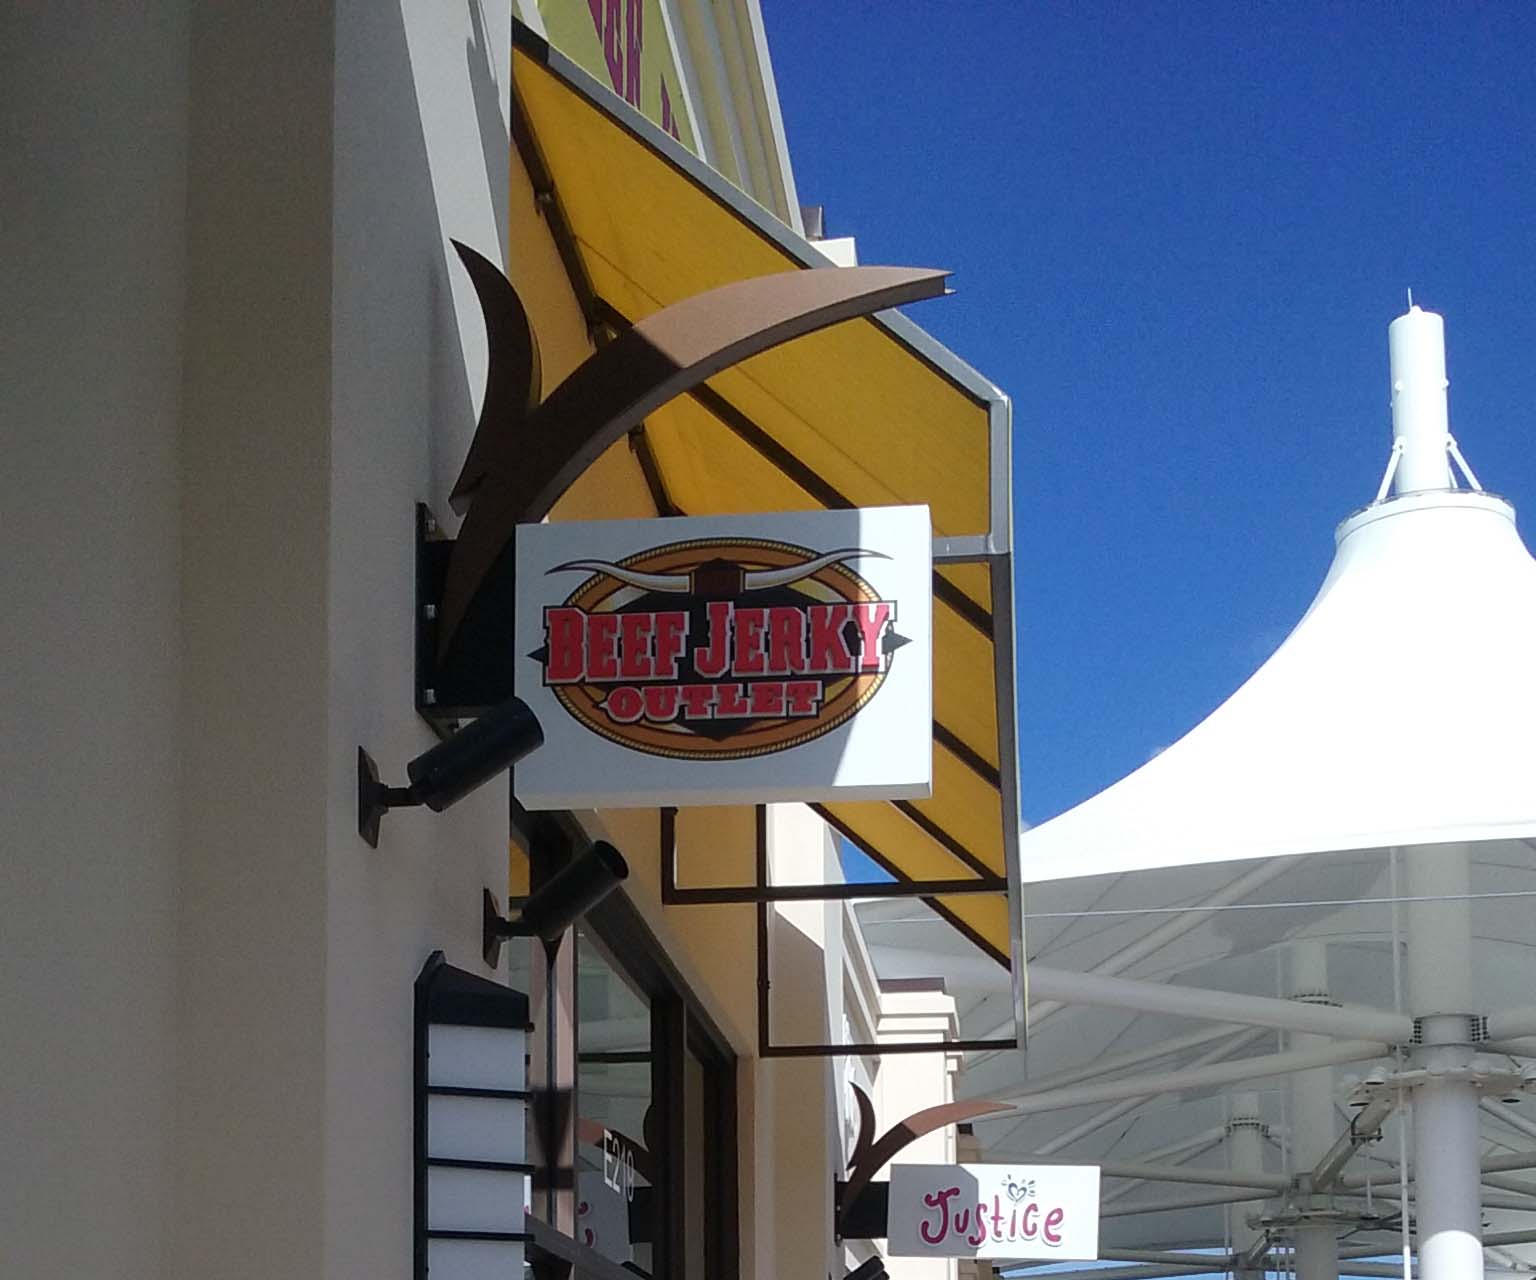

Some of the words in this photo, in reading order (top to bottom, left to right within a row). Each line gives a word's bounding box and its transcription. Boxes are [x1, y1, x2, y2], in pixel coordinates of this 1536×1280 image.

[545, 606, 691, 683] BEEF
[694, 600, 896, 678] JERKY
[604, 681, 822, 722] OUTLET
[920, 1186, 1065, 1247] Justice
